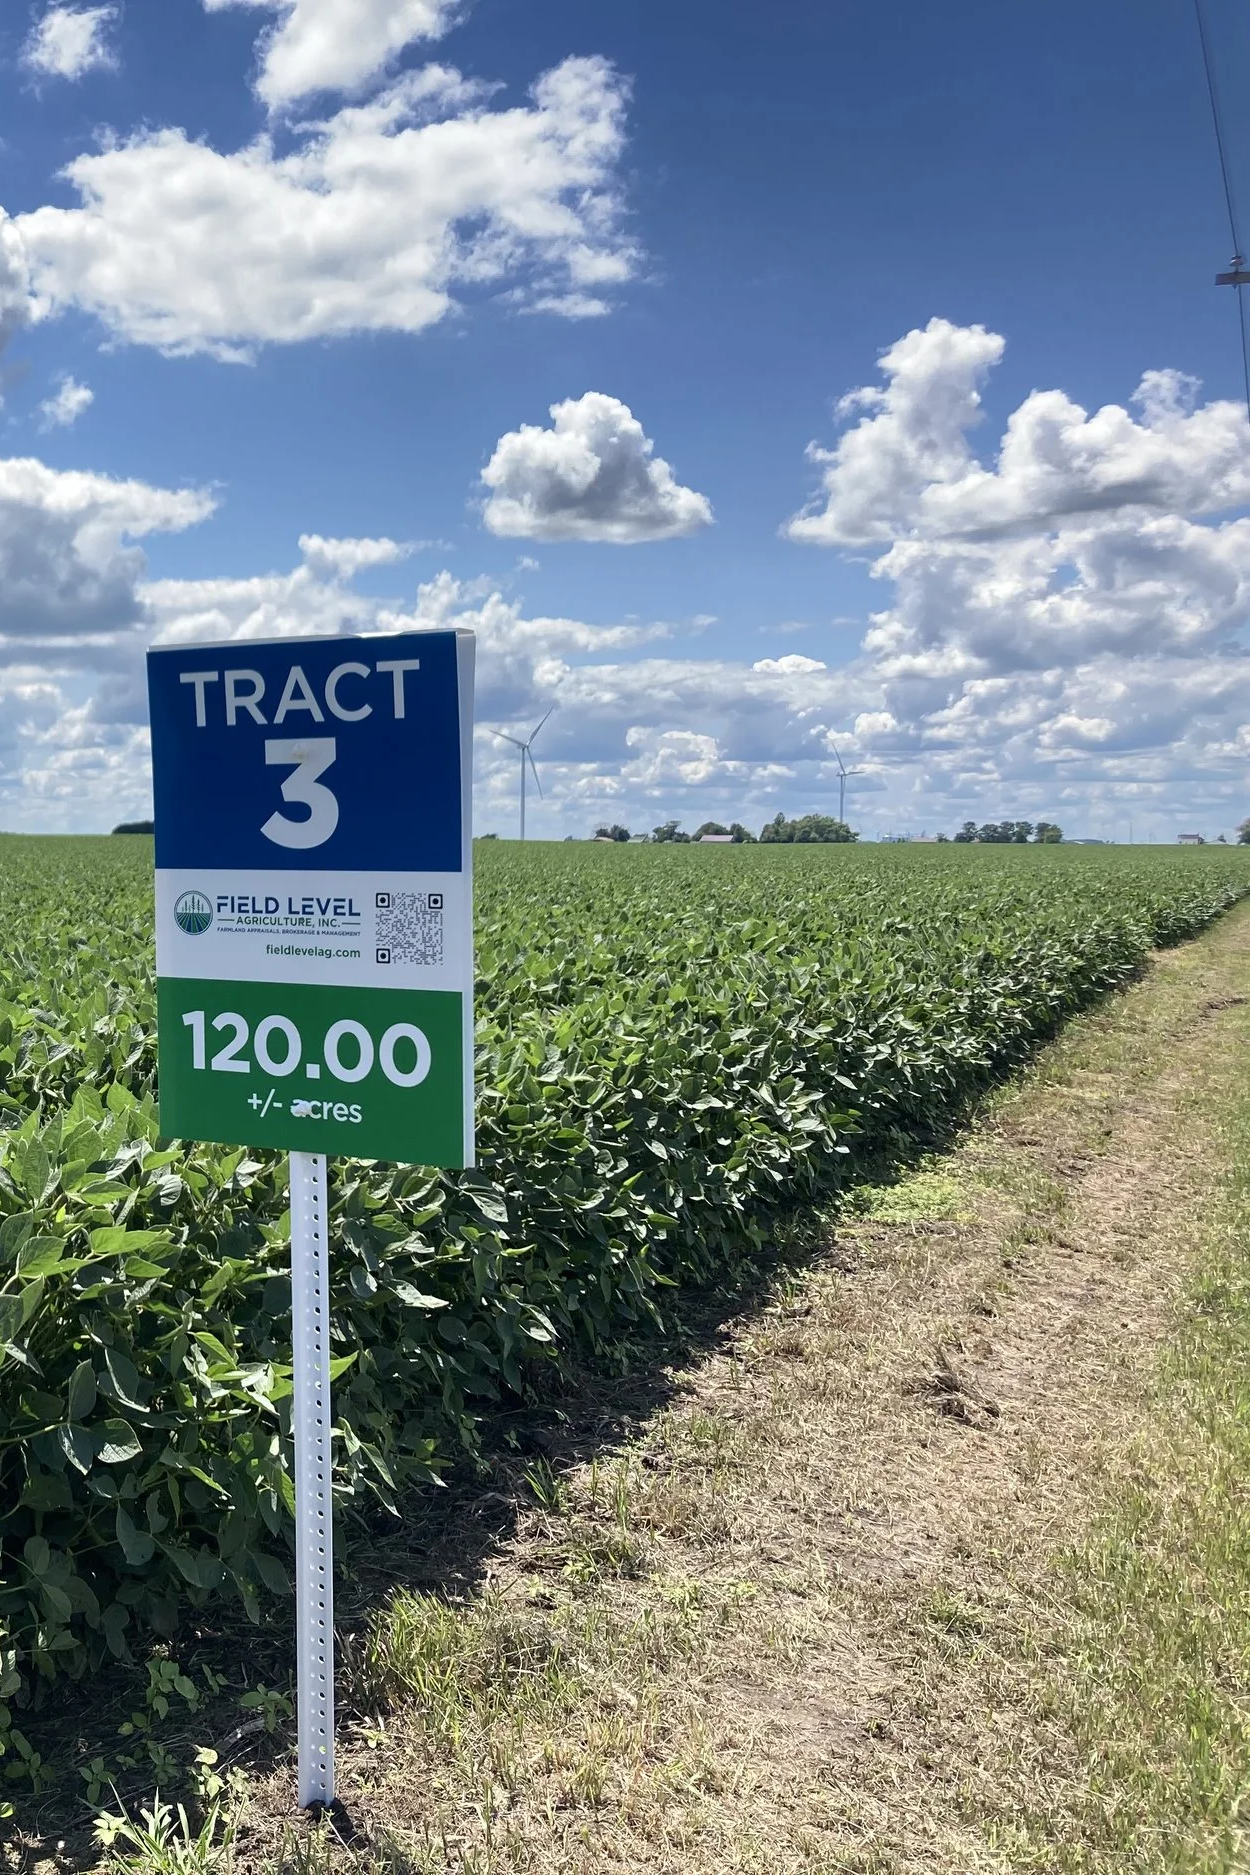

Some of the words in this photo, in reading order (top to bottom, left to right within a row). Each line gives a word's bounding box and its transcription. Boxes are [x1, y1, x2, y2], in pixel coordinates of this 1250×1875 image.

[179, 658, 421, 728] TRACT
[260, 736, 339, 850] 3
[216, 895, 280, 914] FIELD
[287, 896, 361, 917] LEVEL
[236, 916, 315, 928] AGRICULTURE,
[318, 918, 341, 928] INC.
[265, 944, 361, 959] fieldlevelag.com
[181, 1010, 432, 1088] 120.00
[247, 1088, 283, 1118] +/-
